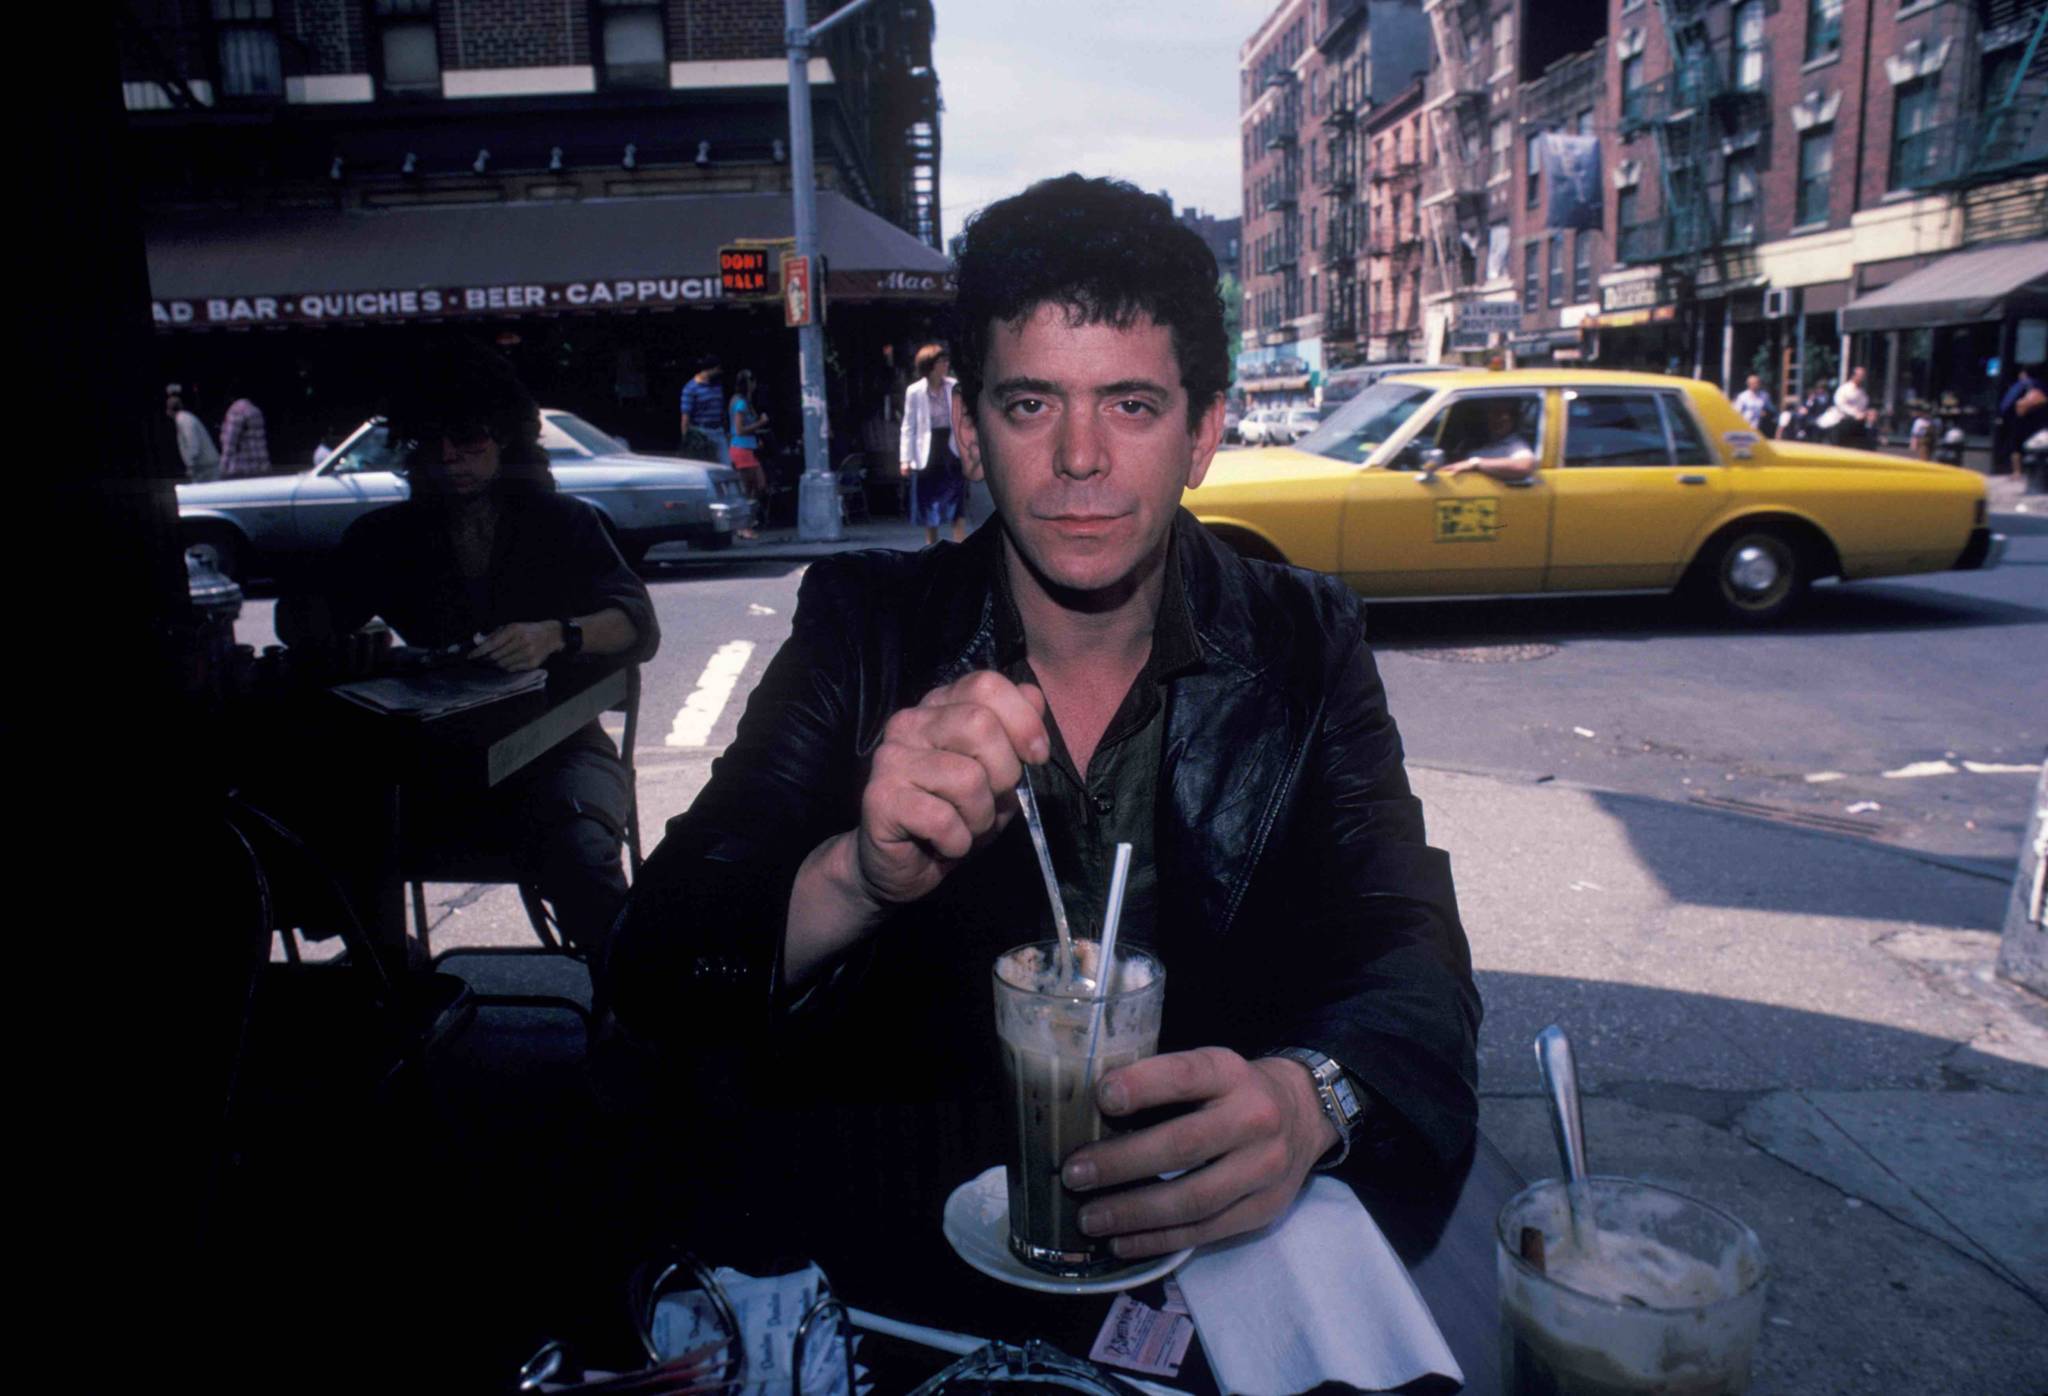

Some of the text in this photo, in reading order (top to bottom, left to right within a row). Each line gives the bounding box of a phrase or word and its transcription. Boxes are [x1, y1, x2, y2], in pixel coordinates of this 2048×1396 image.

[723, 274, 764, 289] WALK
[207, 298, 278, 321] BAR
[301, 290, 442, 319] QUICHES
[465, 286, 546, 308] BEER
